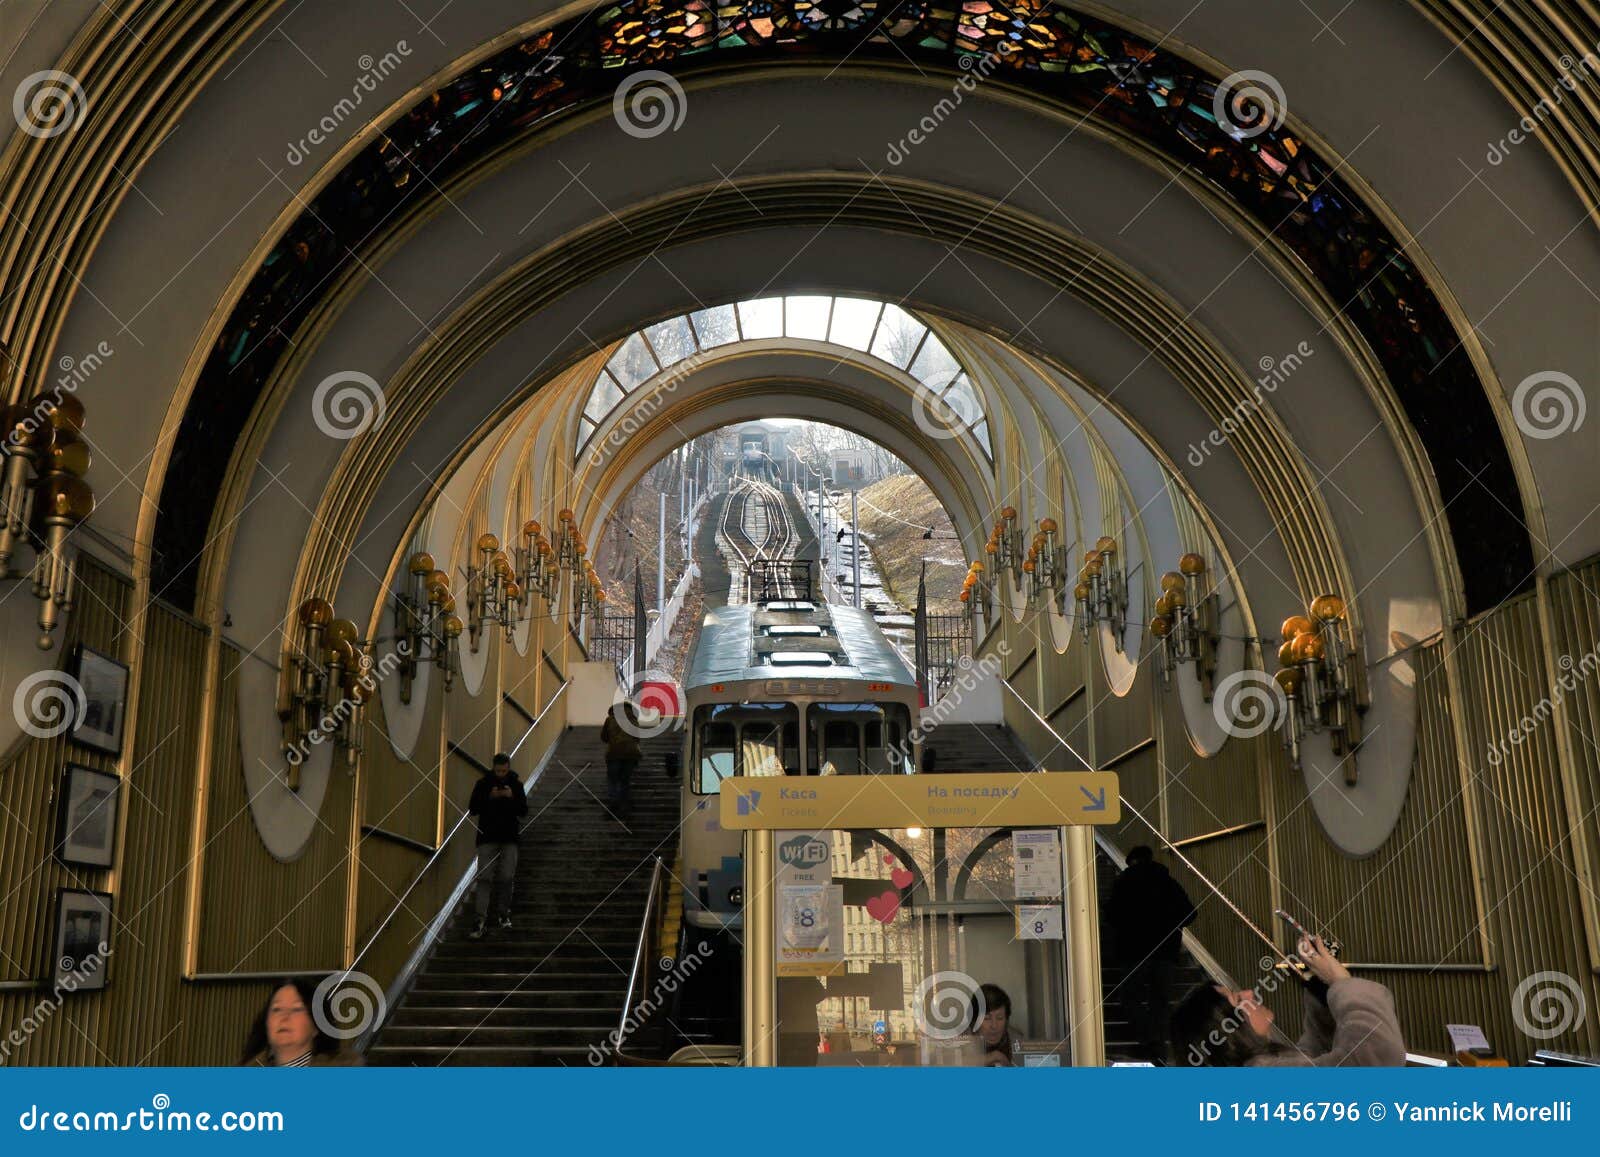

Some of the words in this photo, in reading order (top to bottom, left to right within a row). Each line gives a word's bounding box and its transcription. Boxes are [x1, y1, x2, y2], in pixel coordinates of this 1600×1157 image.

[780, 788, 817, 800] Каса
[927, 786, 948, 798] На
[953, 786, 1020, 800] посадку
[794, 873, 815, 881] FREE
[800, 907, 815, 928] 8
